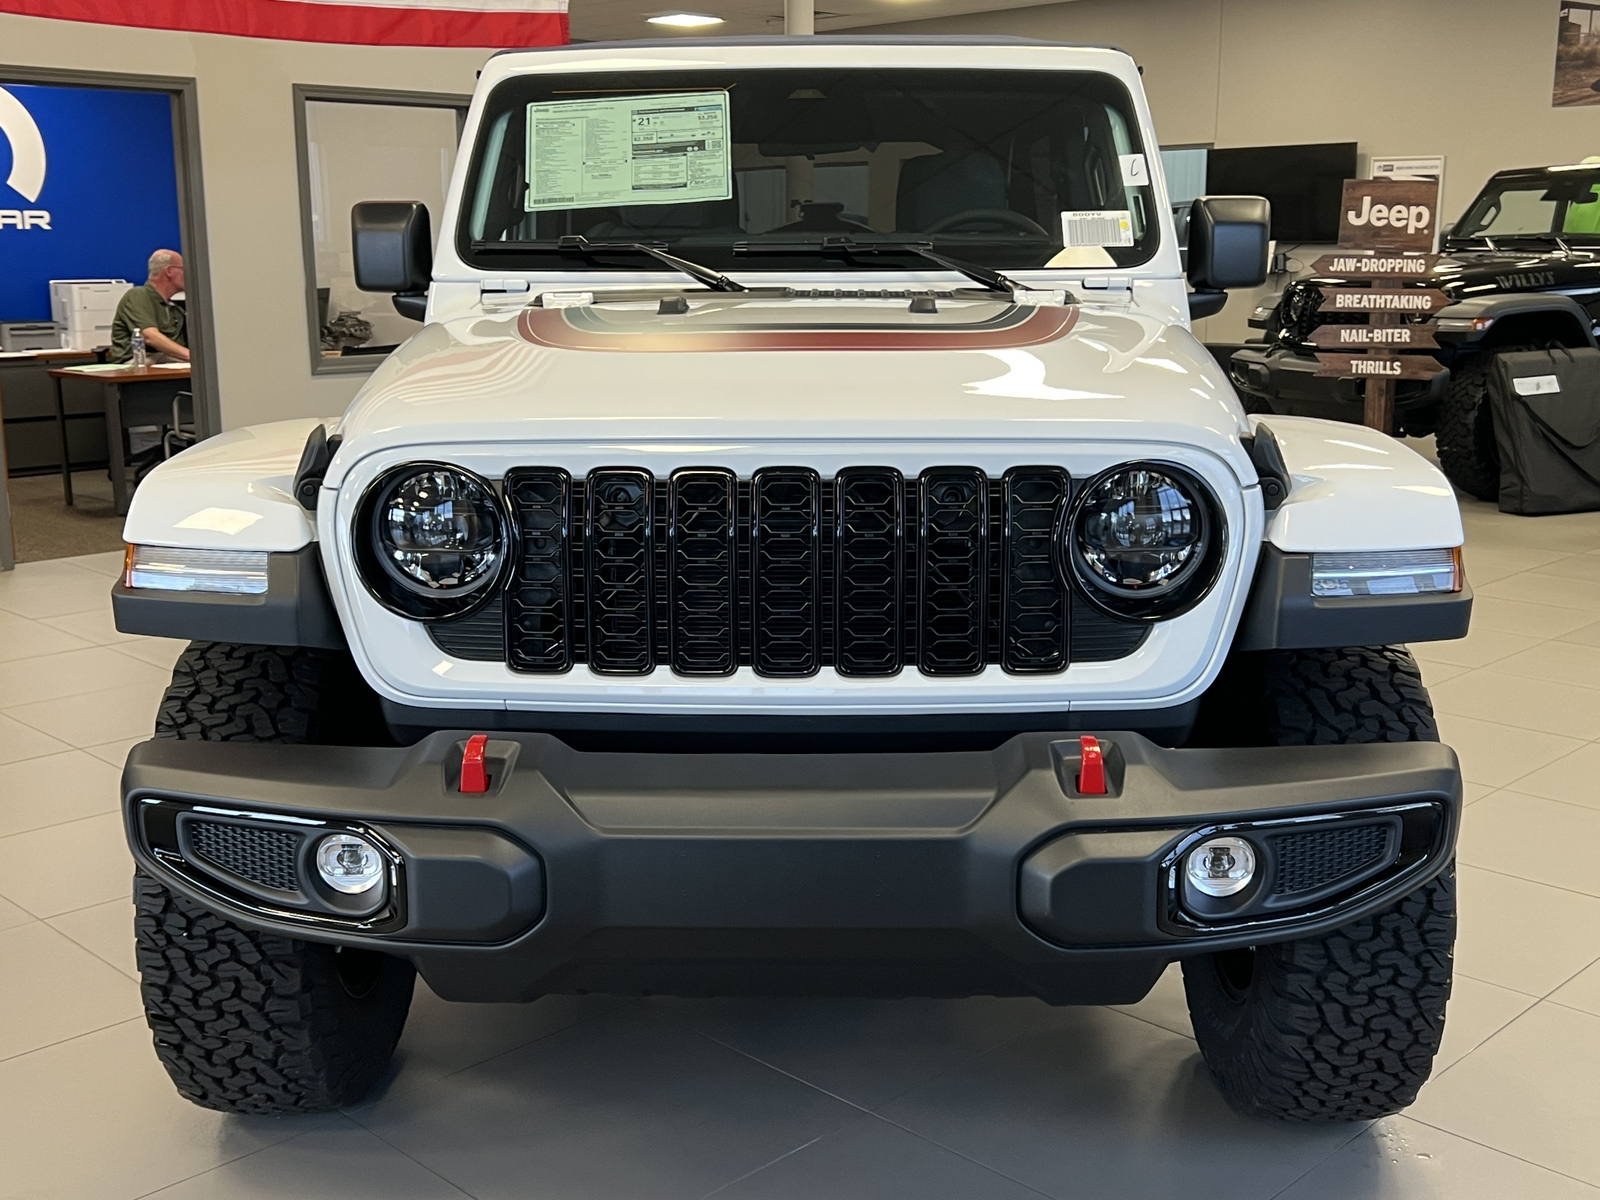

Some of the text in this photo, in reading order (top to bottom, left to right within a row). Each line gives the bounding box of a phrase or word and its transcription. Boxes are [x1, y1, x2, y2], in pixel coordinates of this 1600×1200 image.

[638, 117, 650, 126] 21
[1347, 195, 1430, 235] Jeep
[1328, 257, 1426, 274] JAW-DROPPING
[1495, 271, 1555, 289] WILLYS
[1335, 293, 1433, 310] BREATHTAKING
[1340, 328, 1411, 343] NAIL-BITER
[1350, 360, 1402, 375] THRILLS
